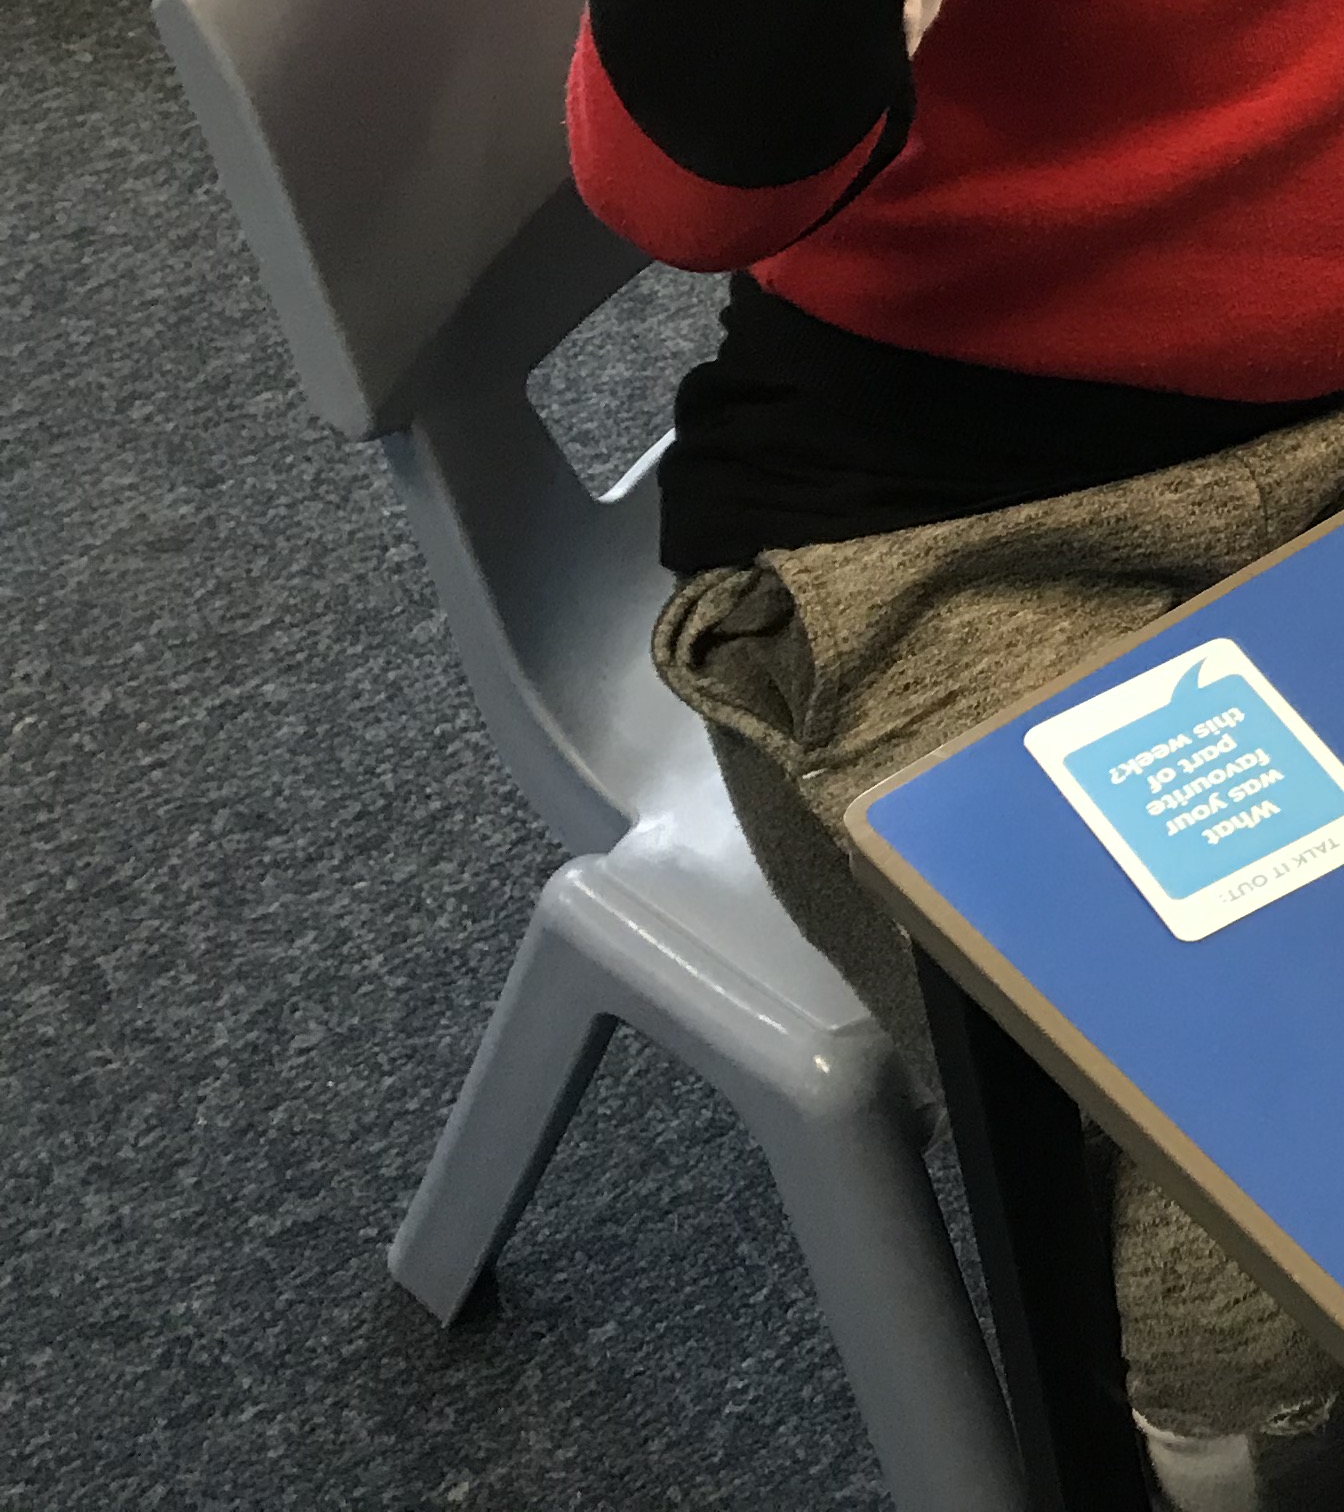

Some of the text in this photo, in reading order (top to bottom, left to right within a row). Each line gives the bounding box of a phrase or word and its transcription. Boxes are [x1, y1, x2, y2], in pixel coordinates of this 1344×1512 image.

[1109, 707, 1245, 784] this week?
[1147, 733, 1237, 794] part of
[1146, 748, 1271, 816] favourite
[1166, 769, 1285, 836] was your
[1201, 800, 1281, 845] What
[1218, 838, 1340, 904] TALK IT OUT:
